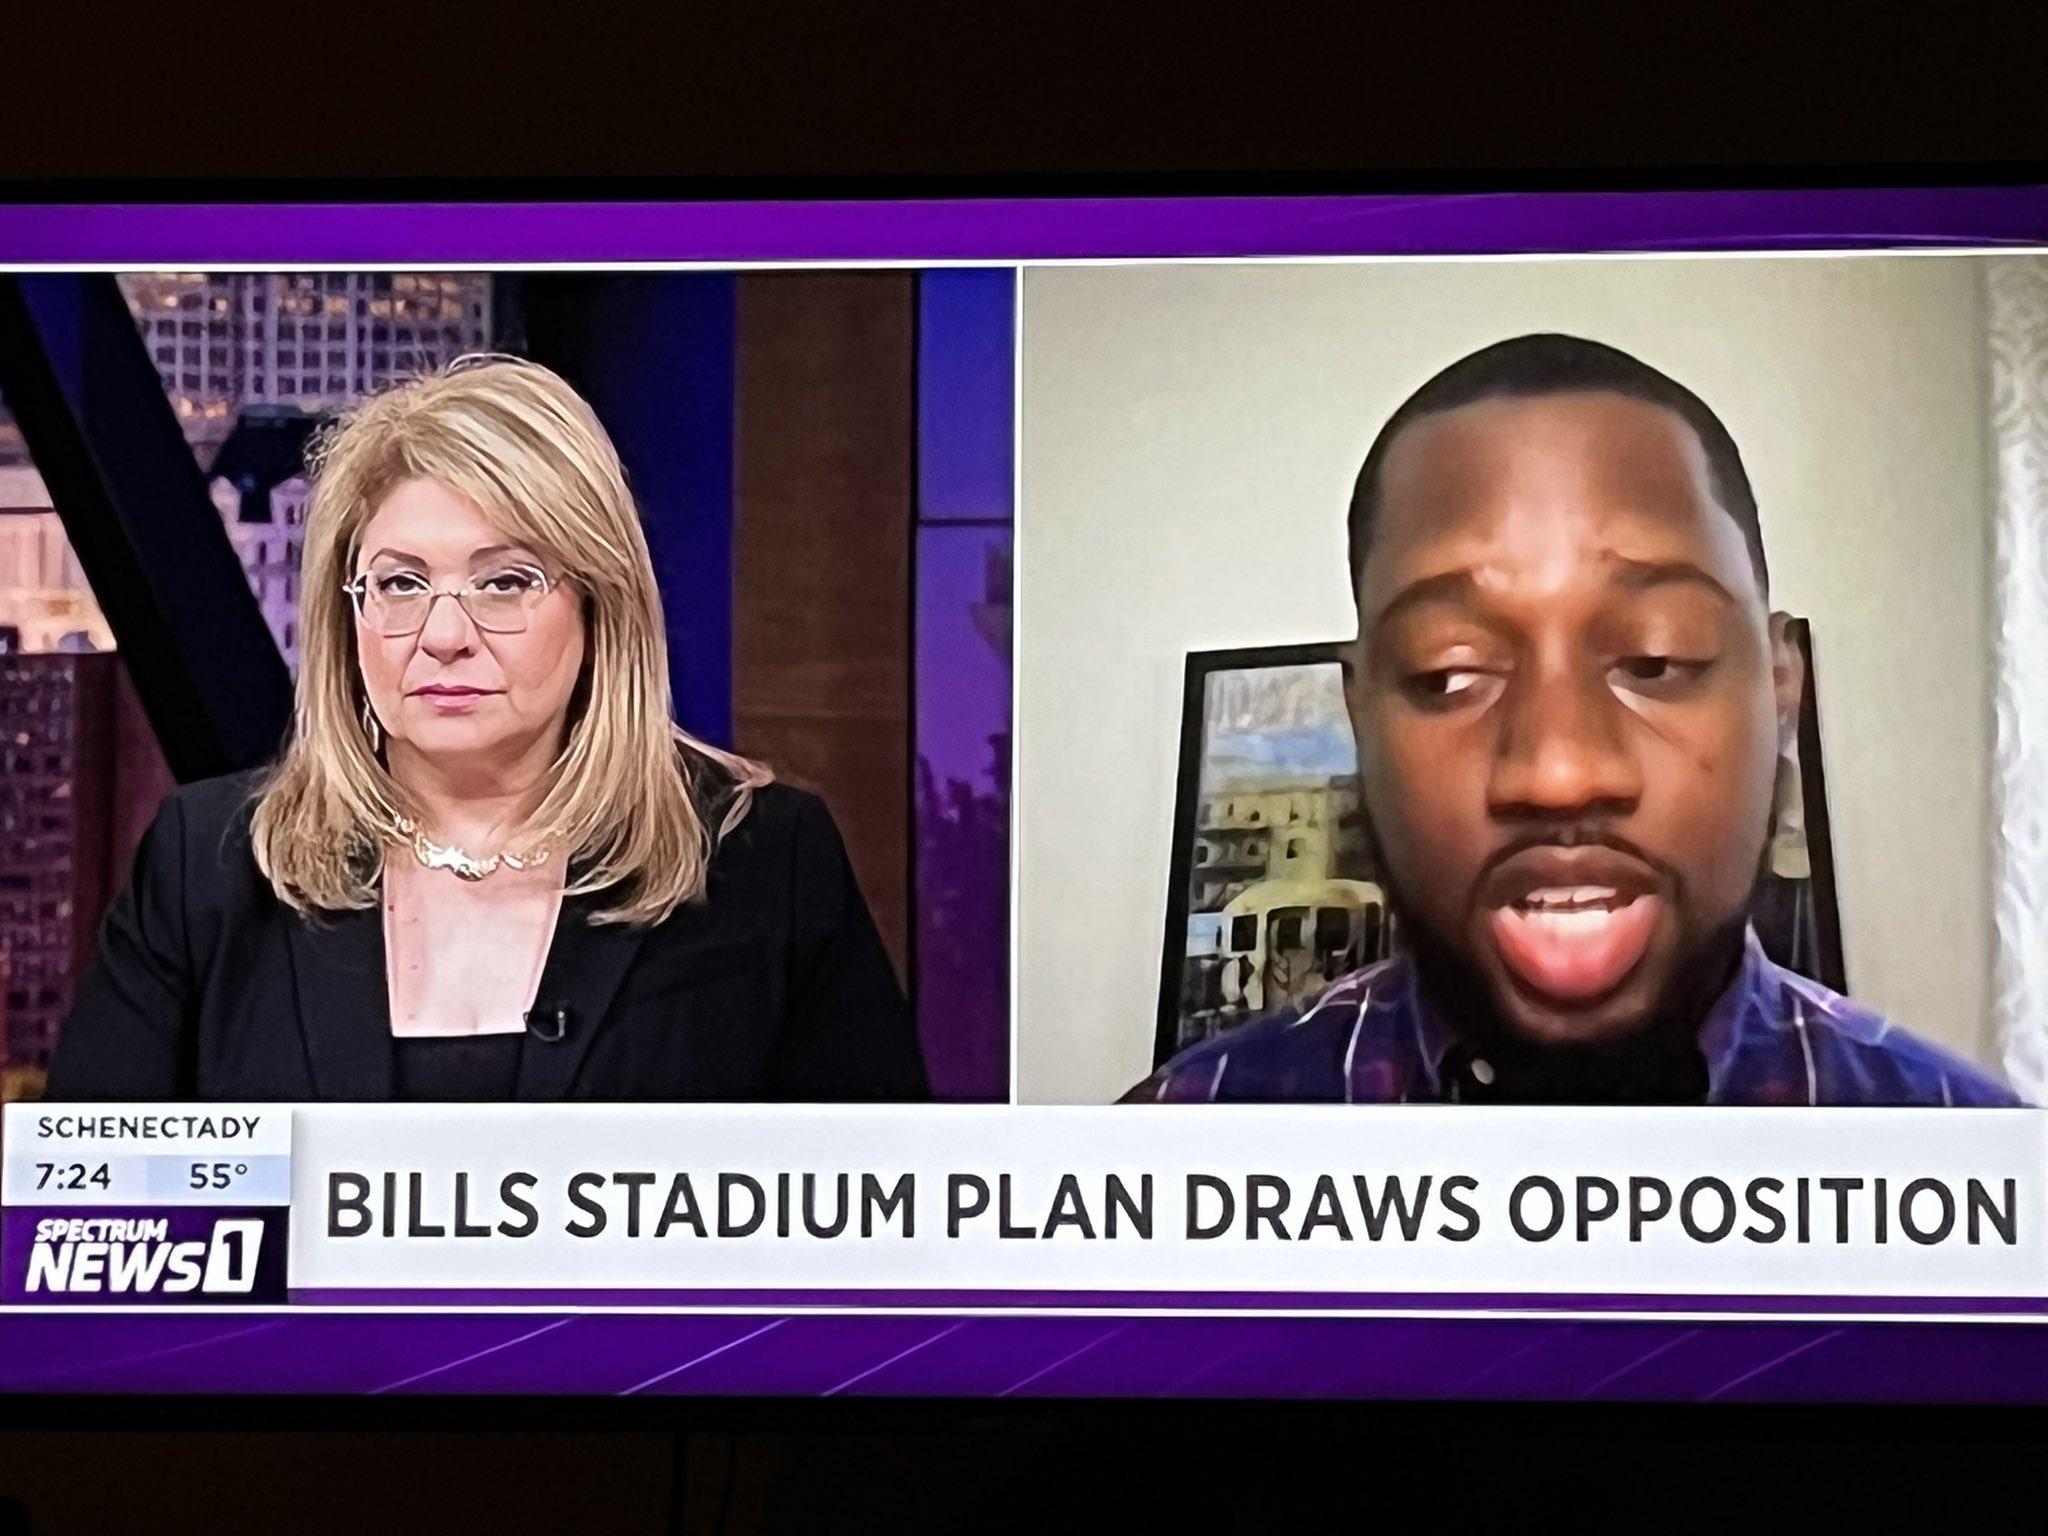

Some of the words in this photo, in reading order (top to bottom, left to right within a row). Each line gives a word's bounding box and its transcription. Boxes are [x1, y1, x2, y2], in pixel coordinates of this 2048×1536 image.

[37, 1116, 261, 1139] SCHENECTADY
[35, 1162, 112, 1190] 7:24
[189, 1162, 248, 1190] 55°
[327, 1172, 539, 1238] BILLS
[565, 1172, 915, 1239] STADIUM
[947, 1173, 1153, 1240] PLAN
[1186, 1174, 1481, 1242] DRAWS
[1508, 1175, 2017, 1246] OPPOSITION
[35, 1218, 169, 1242] SPECTRUM
